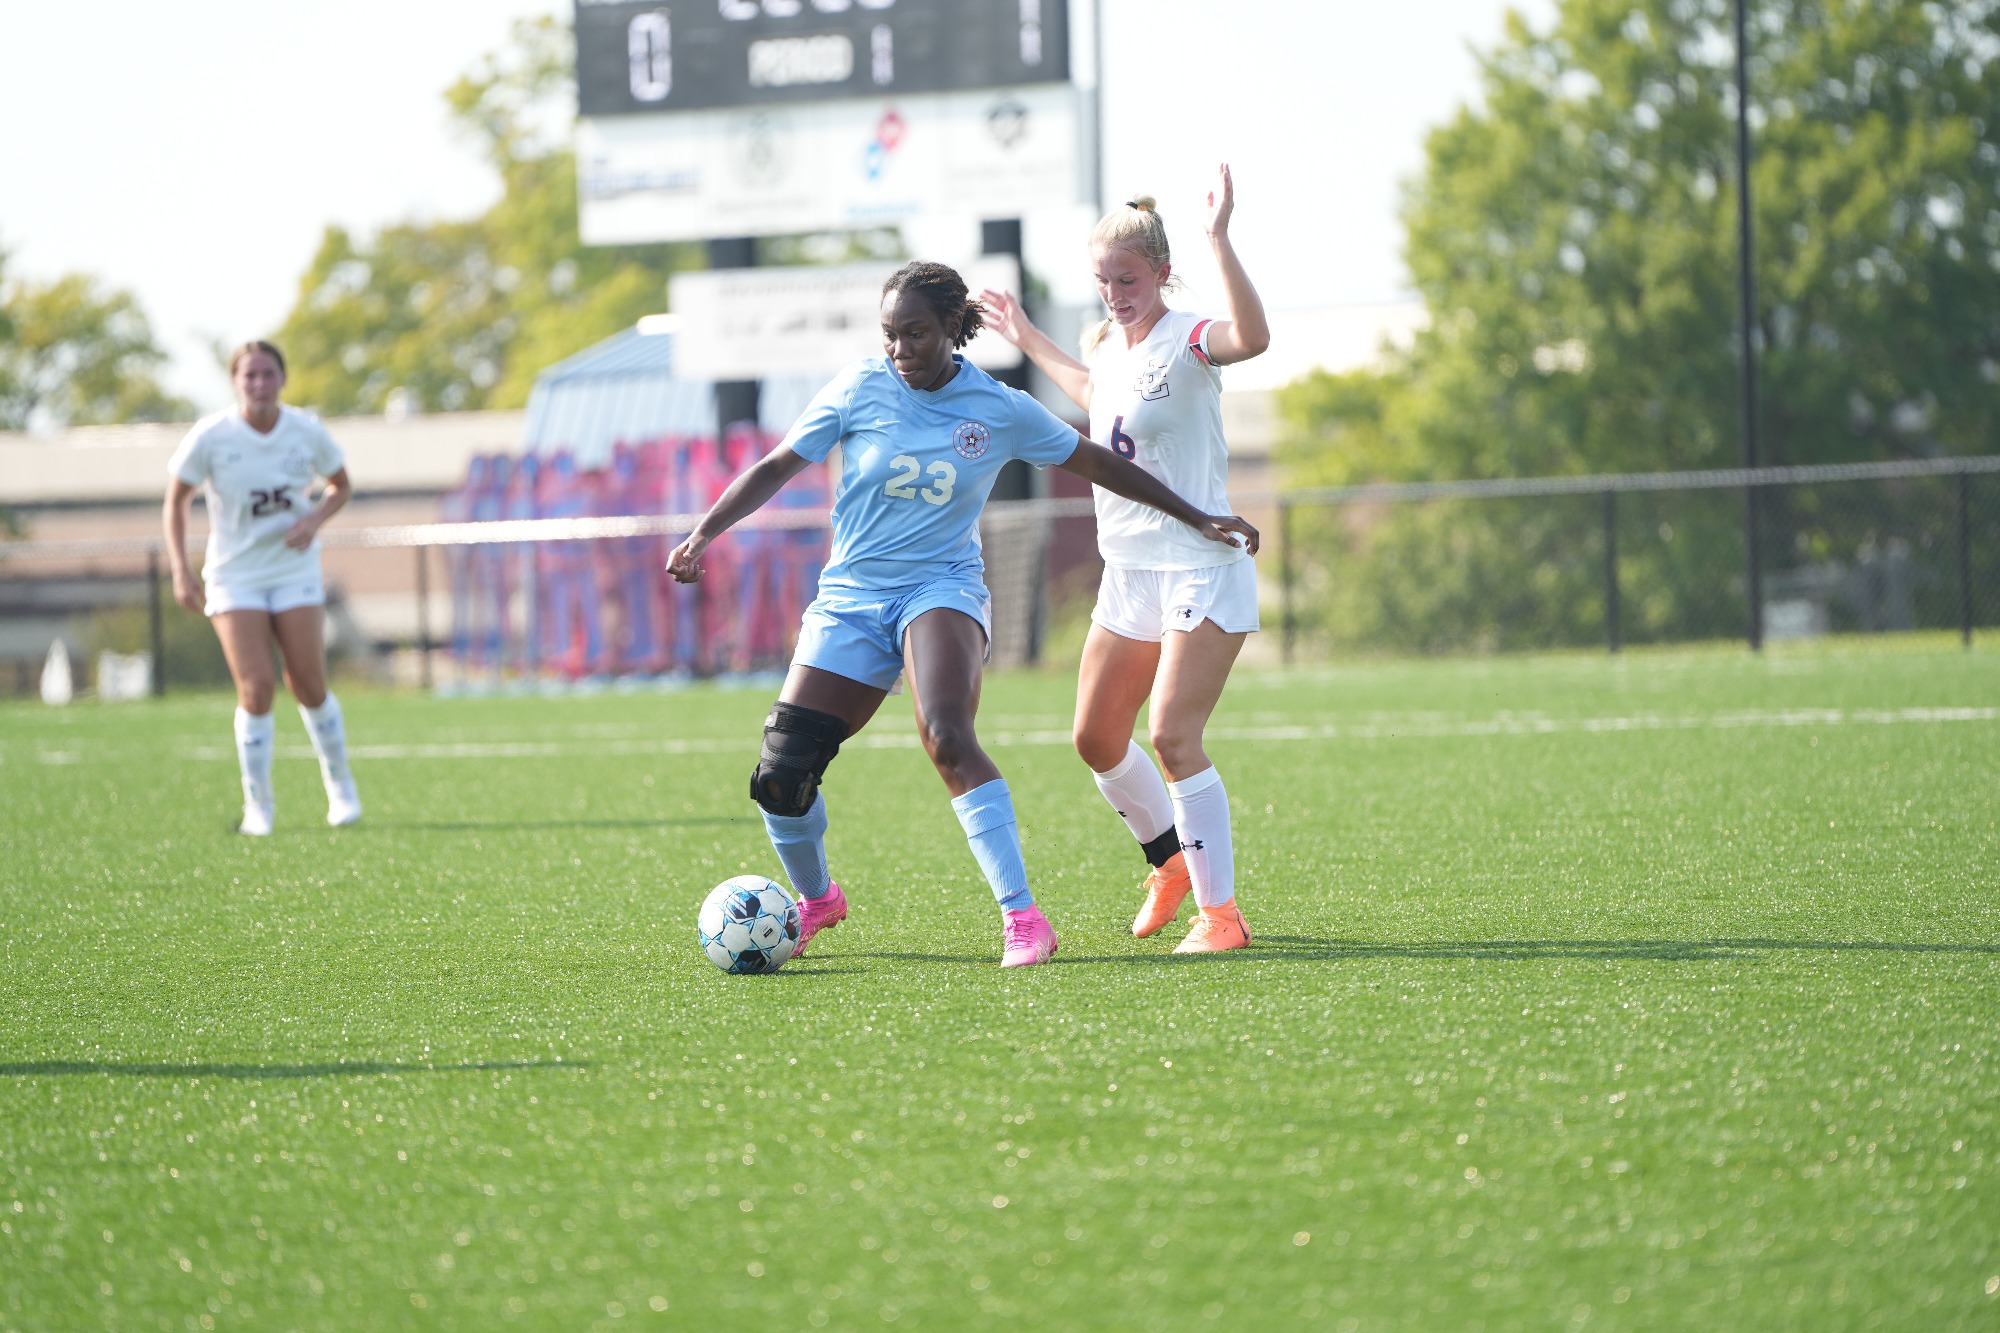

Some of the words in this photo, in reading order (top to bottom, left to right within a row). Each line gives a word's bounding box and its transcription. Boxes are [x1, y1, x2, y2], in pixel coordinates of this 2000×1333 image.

[628, 13, 672, 101] 0
[1111, 415, 1136, 461] 6
[250, 484, 292, 518] 25
[884, 454, 957, 506] 23
